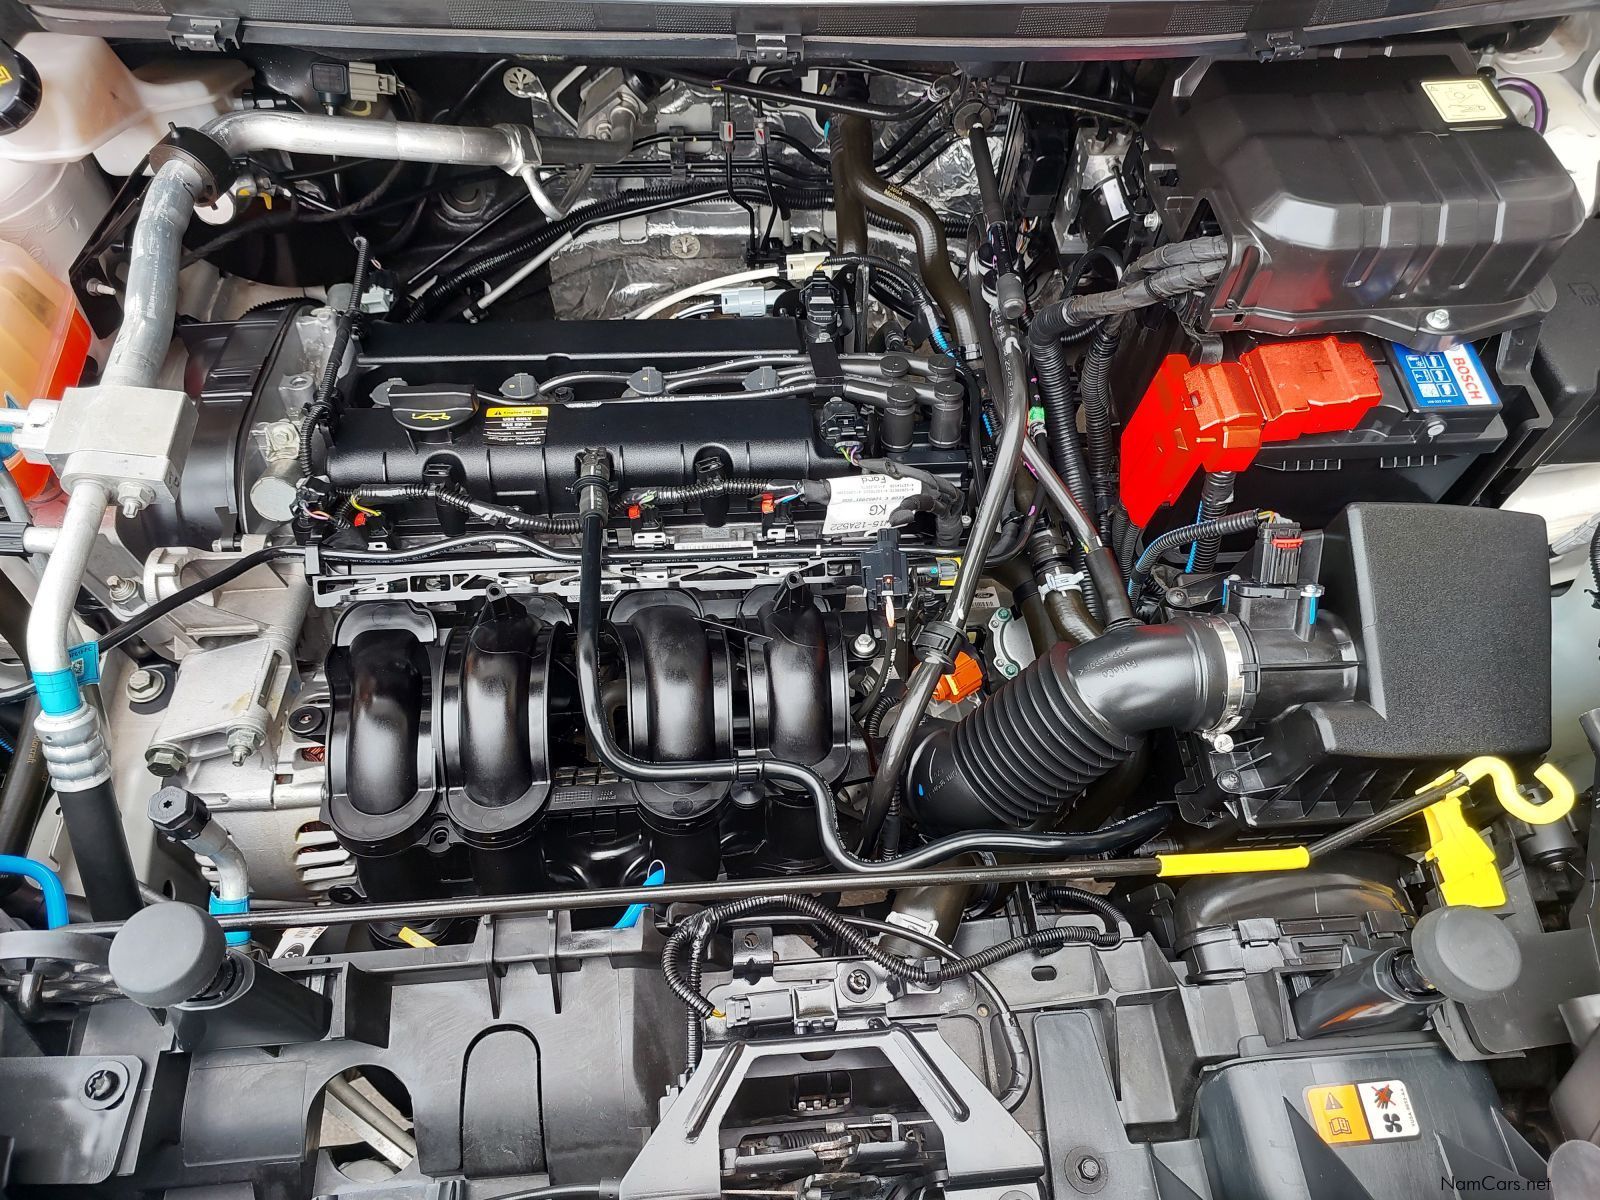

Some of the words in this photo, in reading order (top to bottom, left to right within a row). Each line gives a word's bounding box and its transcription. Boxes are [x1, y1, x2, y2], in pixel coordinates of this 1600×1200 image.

[883, 189, 911, 207] Motorcraft
[1453, 357, 1483, 401] BOSCH
[861, 476, 887, 485] Ford
[869, 504, 887, 516] KG
